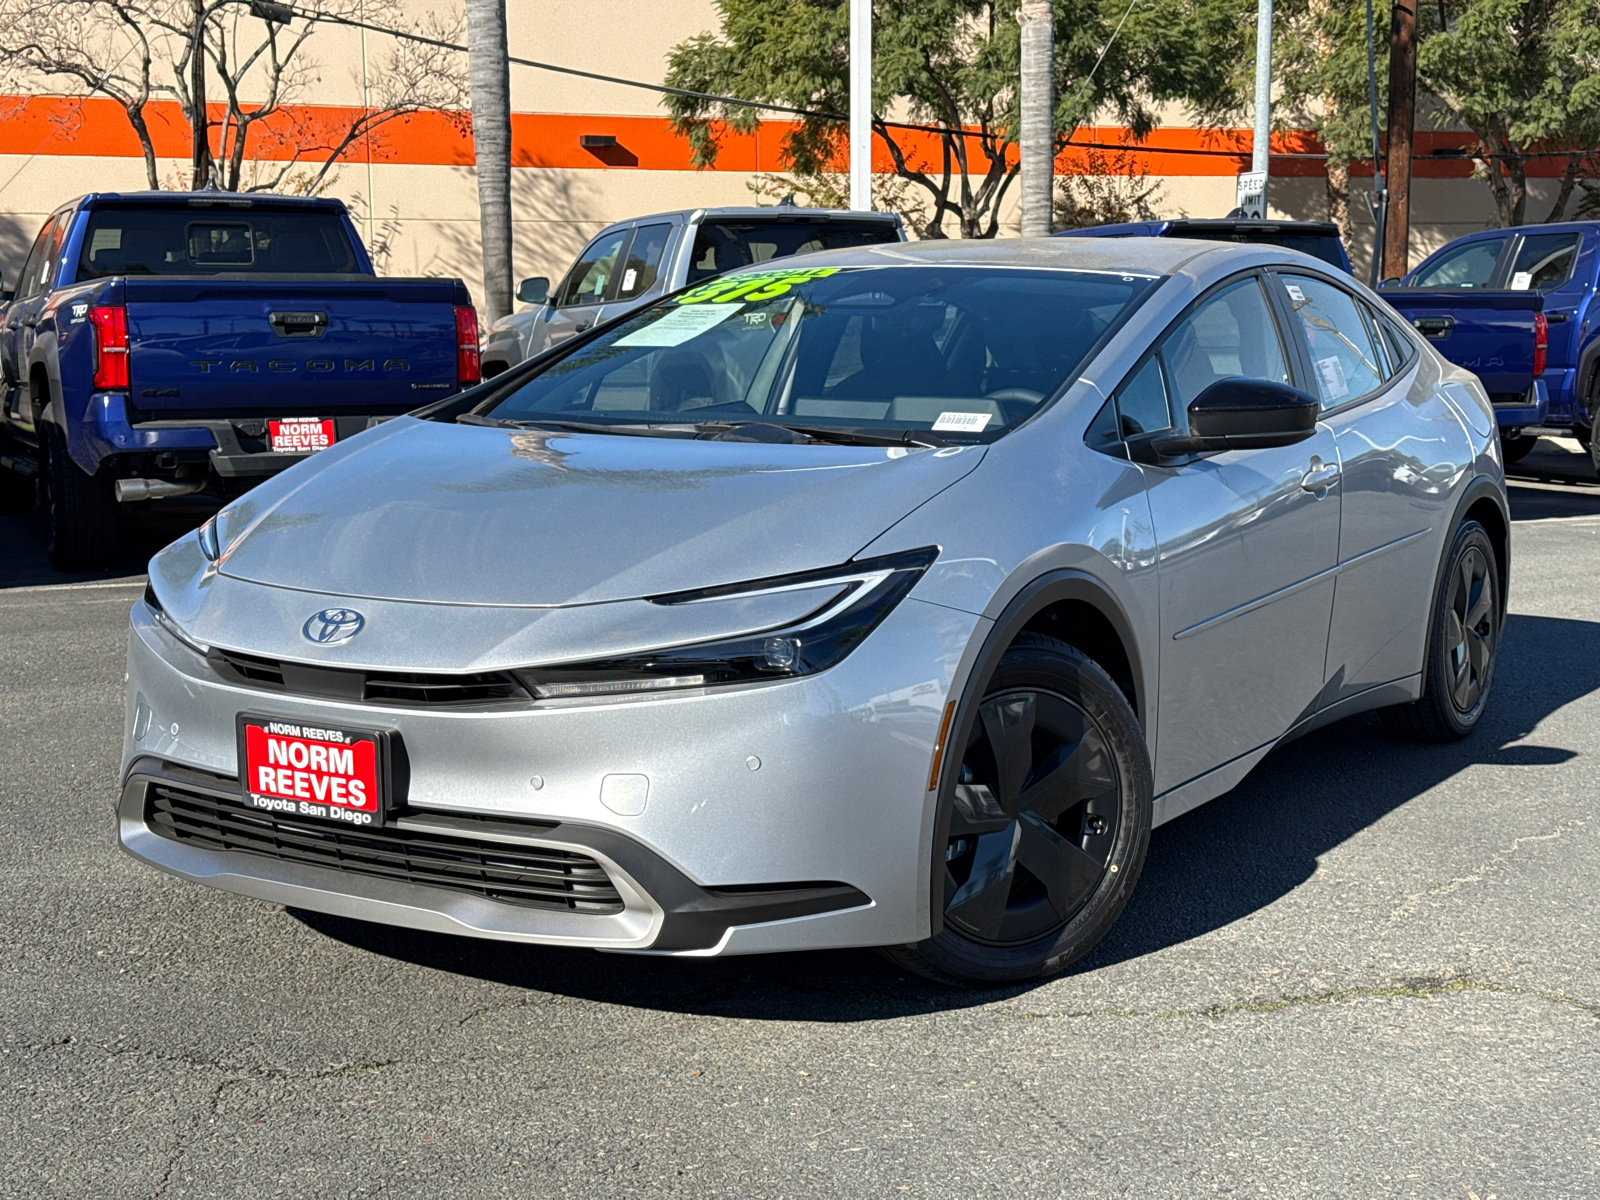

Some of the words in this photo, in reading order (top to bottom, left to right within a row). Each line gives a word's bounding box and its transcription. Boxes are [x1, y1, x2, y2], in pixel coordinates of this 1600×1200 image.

[1238, 180, 1264, 191] SPEED
[672, 277, 811, 304] $375
[744, 312, 767, 325] TRD
[189, 359, 410, 373] TACOMA
[279, 424, 323, 435] NORM
[274, 434, 329, 446] REEVES
[269, 721, 301, 737] NORM
[302, 726, 344, 743] REEVES
[267, 738, 354, 776] NORM
[258, 765, 367, 807] REEVES
[250, 793, 296, 811] Toyota
[299, 801, 327, 817] San
[329, 806, 372, 825] Diego
